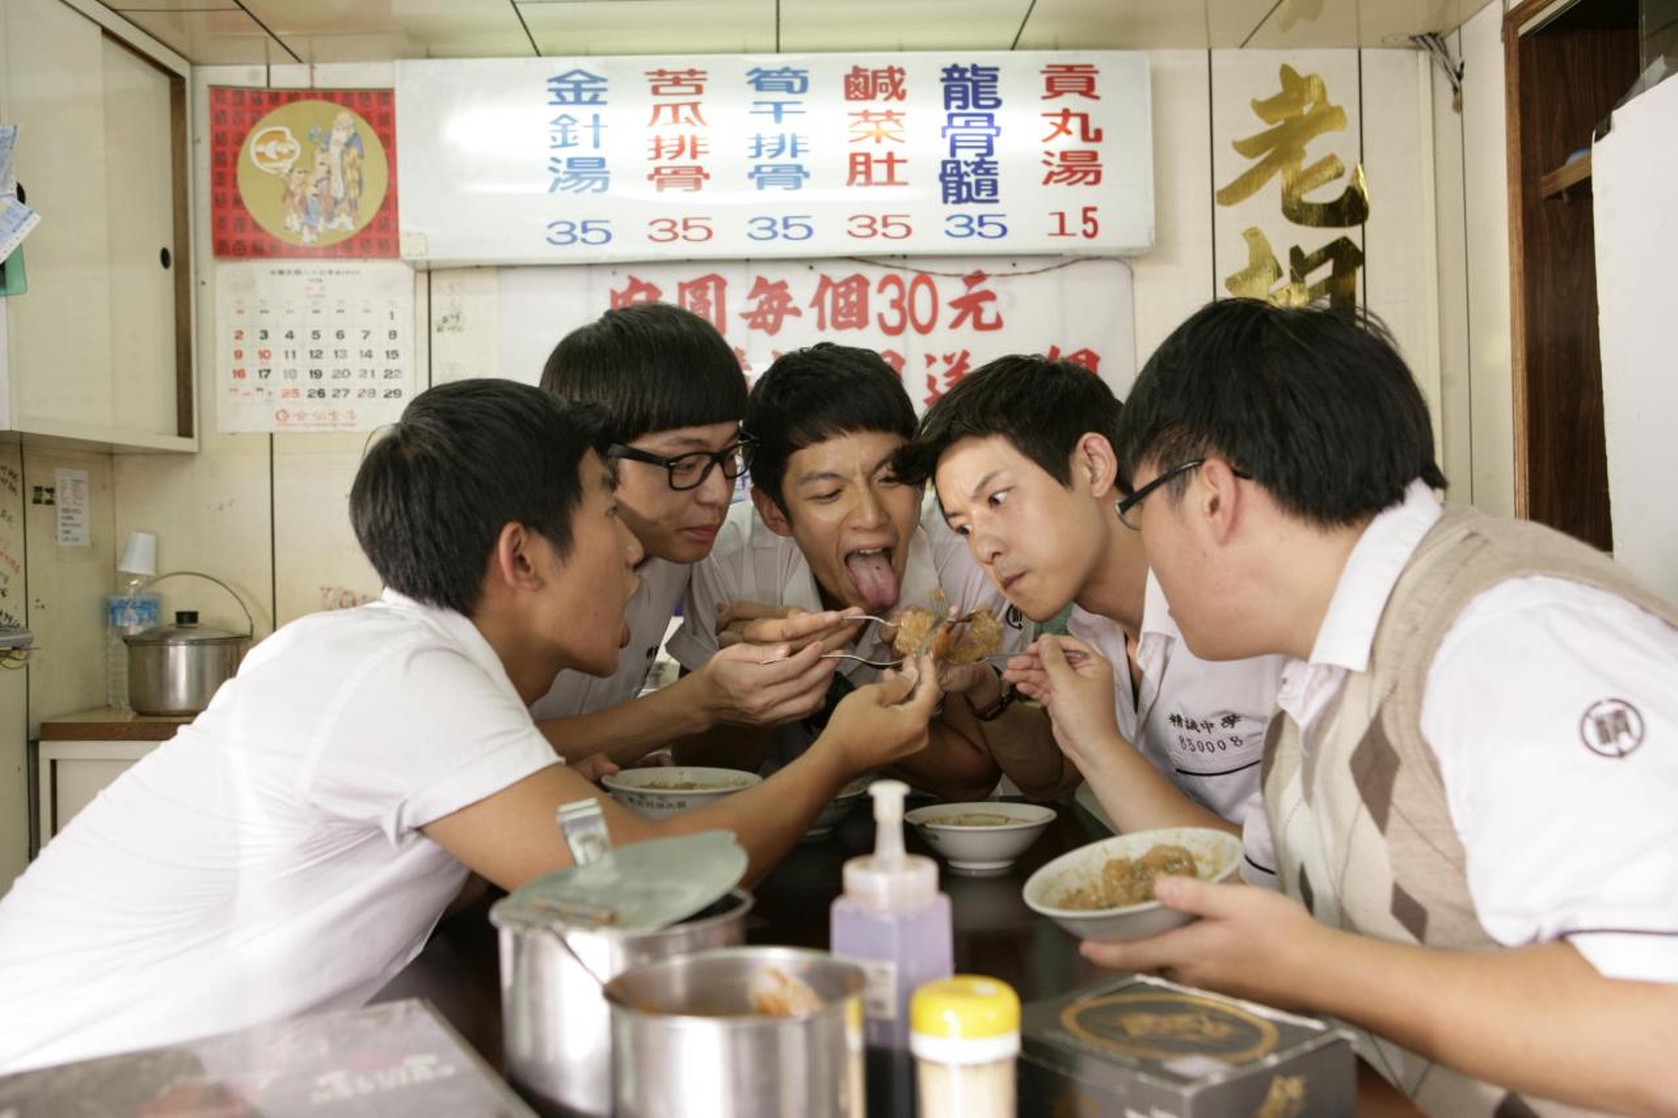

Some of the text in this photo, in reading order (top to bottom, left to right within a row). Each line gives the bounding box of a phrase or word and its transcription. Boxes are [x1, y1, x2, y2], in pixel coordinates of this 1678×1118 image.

[546, 69, 610, 193] 金針湯
[644, 68, 710, 190] 苦瓜排骨
[844, 65, 908, 186] 鹹菜肚
[939, 63, 1002, 204] 龍骨髓
[1040, 64, 1103, 186] 貢丸湯
[546, 220, 612, 245] 35
[648, 218, 713, 242] 35
[747, 216, 813, 240] 35
[847, 215, 912, 239] 35
[945, 214, 1007, 239] 35
[1049, 206, 1098, 239] 15
[257, 349, 272, 361] 10
[284, 349, 297, 360] 11
[308, 348, 324, 360] 12
[359, 349, 374, 360] 14
[385, 349, 400, 361] 15
[232, 368, 247, 380] 16
[258, 368, 272, 379] 17
[308, 368, 323, 380] 19
[331, 368, 352, 380] 20
[358, 368, 376, 379] 21
[383, 368, 402, 380] 22
[281, 387, 300, 399] 25
[307, 388, 326, 399] 26
[331, 388, 351, 399] 27
[383, 388, 403, 399] 29
